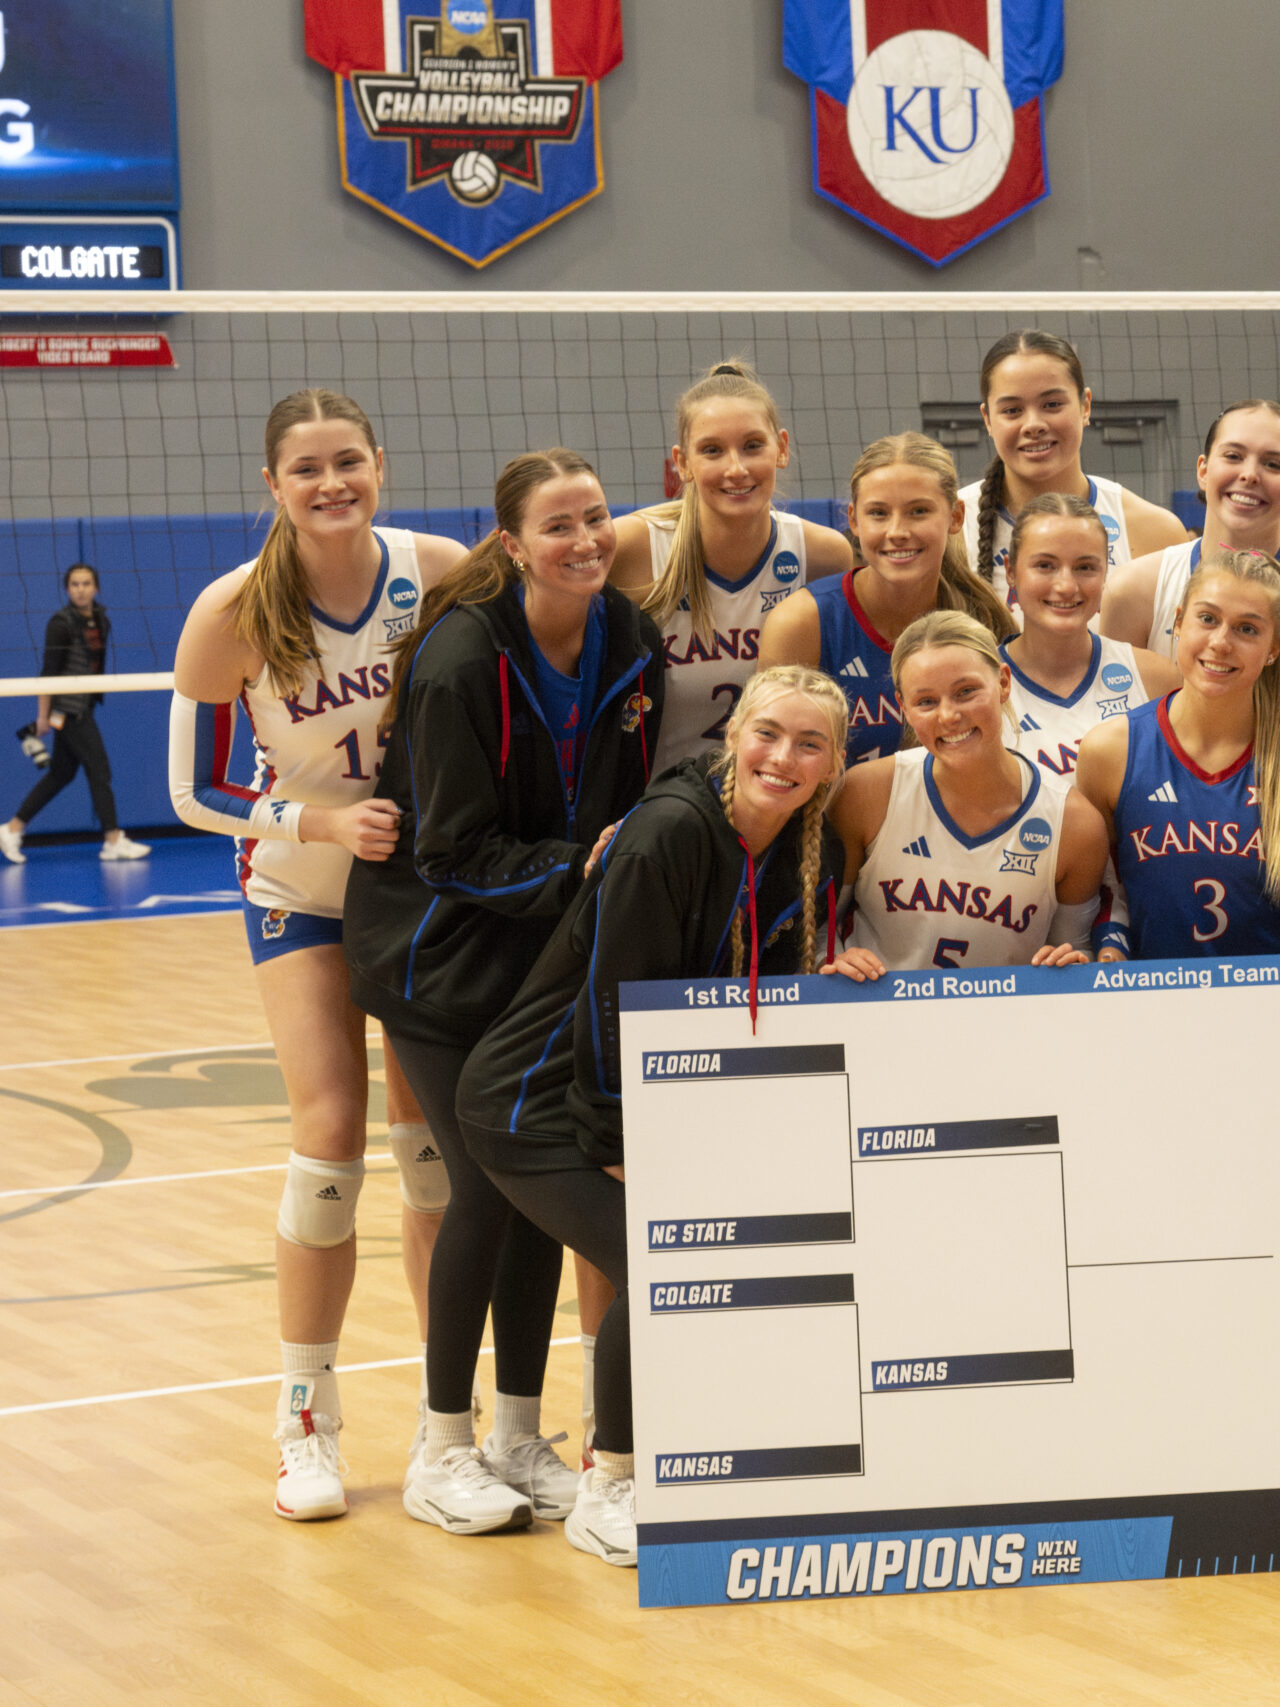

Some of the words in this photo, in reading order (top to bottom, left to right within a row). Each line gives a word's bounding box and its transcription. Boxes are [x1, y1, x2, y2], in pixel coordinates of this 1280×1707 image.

[419, 70, 522, 93] VOLLEYBALL
[375, 91, 571, 124] CHAMPIONSHIP
[876, 84, 982, 164] KU
[21, 245, 141, 279] COLGATE
[393, 590, 417, 603] NCAA
[663, 628, 760, 668] KANS
[1107, 674, 1132, 686] NCAA
[279, 663, 392, 724] KANS
[1022, 832, 1050, 844] NCAA
[1130, 820, 1267, 863] KANSA
[878, 878, 1038, 933] KANSAS
[1193, 877, 1230, 942] 3
[893, 977, 936, 998] 2nd
[942, 975, 1017, 996] Round
[1093, 967, 1213, 989] Advancing
[1218, 964, 1280, 984] Team
[684, 986, 719, 1006] 1st
[646, 1053, 721, 1076] FLORIDA
[861, 1128, 936, 1152] FLORIDA
[651, 1225, 678, 1245] NC
[682, 1221, 737, 1243] STATE
[653, 1283, 734, 1307] COLGATE
[875, 1361, 949, 1386] KANSAS
[659, 1455, 733, 1478] KANSAS
[725, 1532, 1026, 1600] CHAMPIONS
[1037, 1540, 1078, 1558] WIN
[1030, 1557, 1082, 1576] HERE
